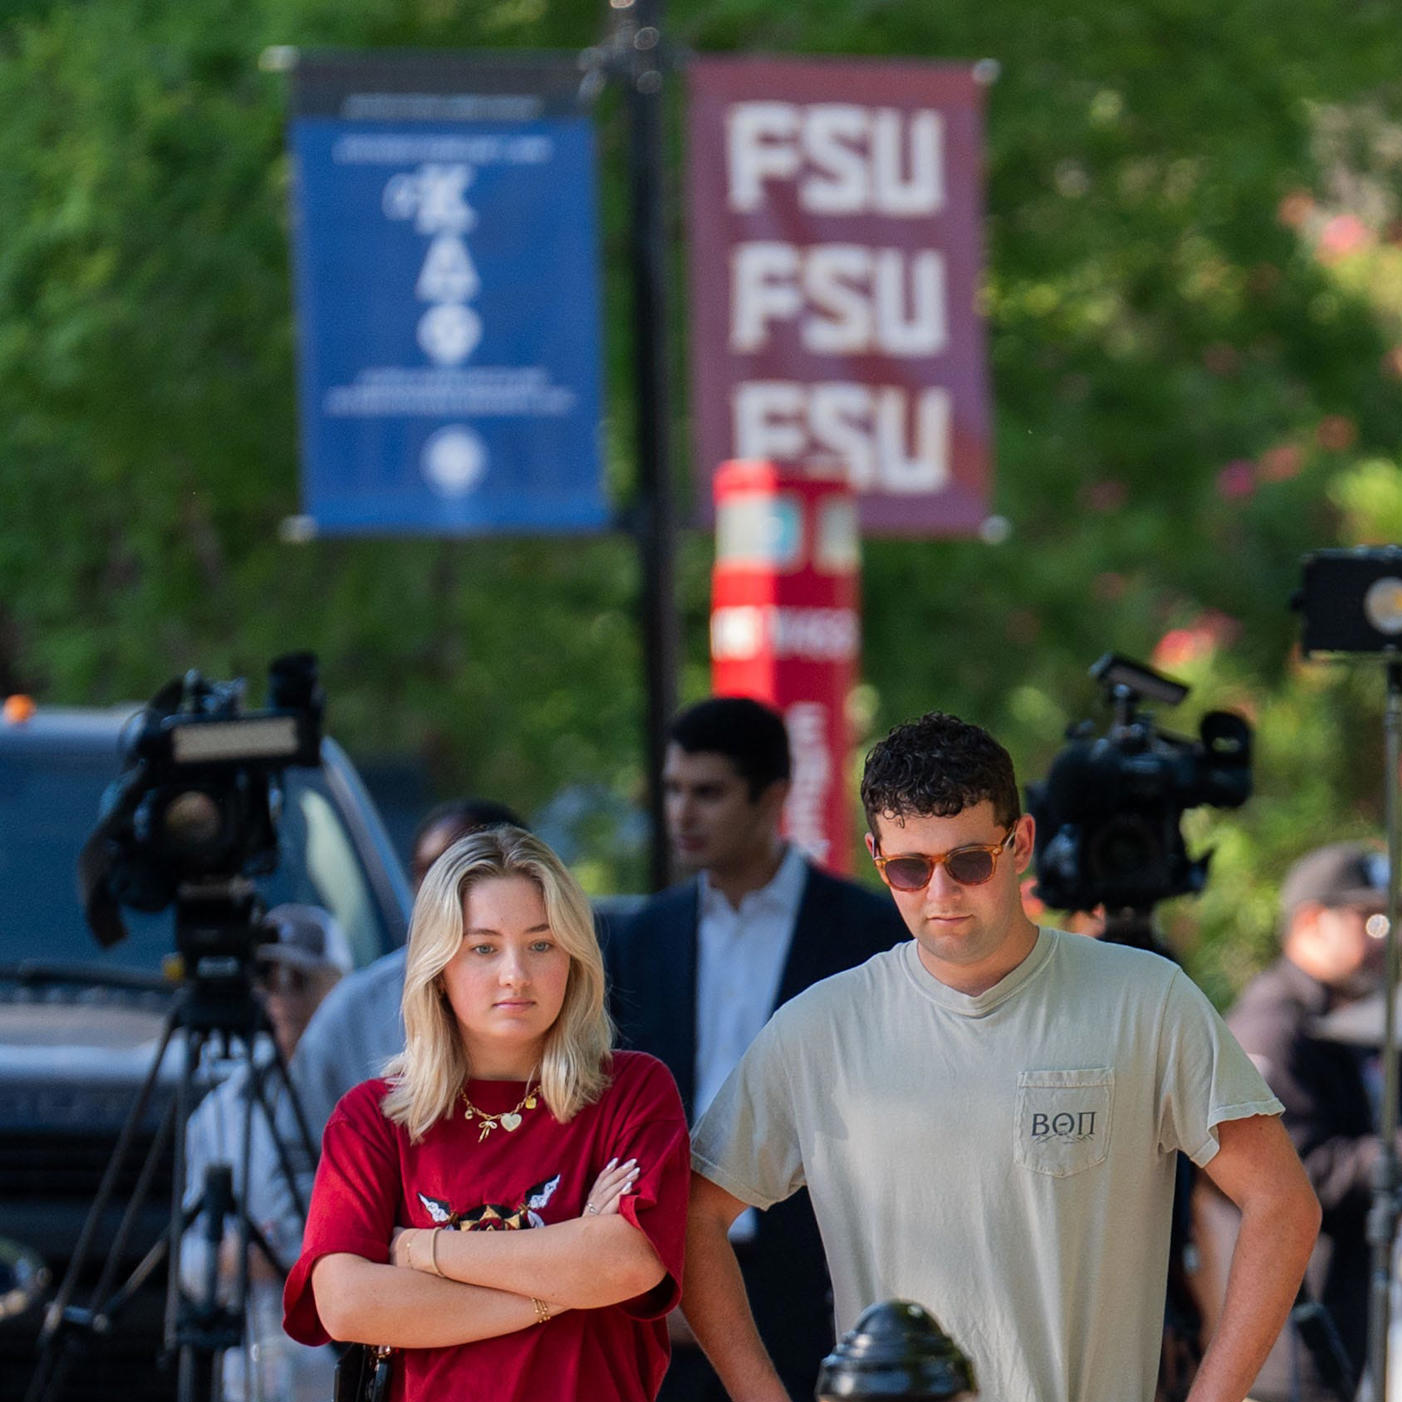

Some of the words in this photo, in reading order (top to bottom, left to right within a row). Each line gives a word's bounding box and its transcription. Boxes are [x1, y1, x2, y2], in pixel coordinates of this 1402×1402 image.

[728, 100, 945, 215] FSU
[732, 242, 947, 356] FSU
[736, 380, 951, 493] FSU
